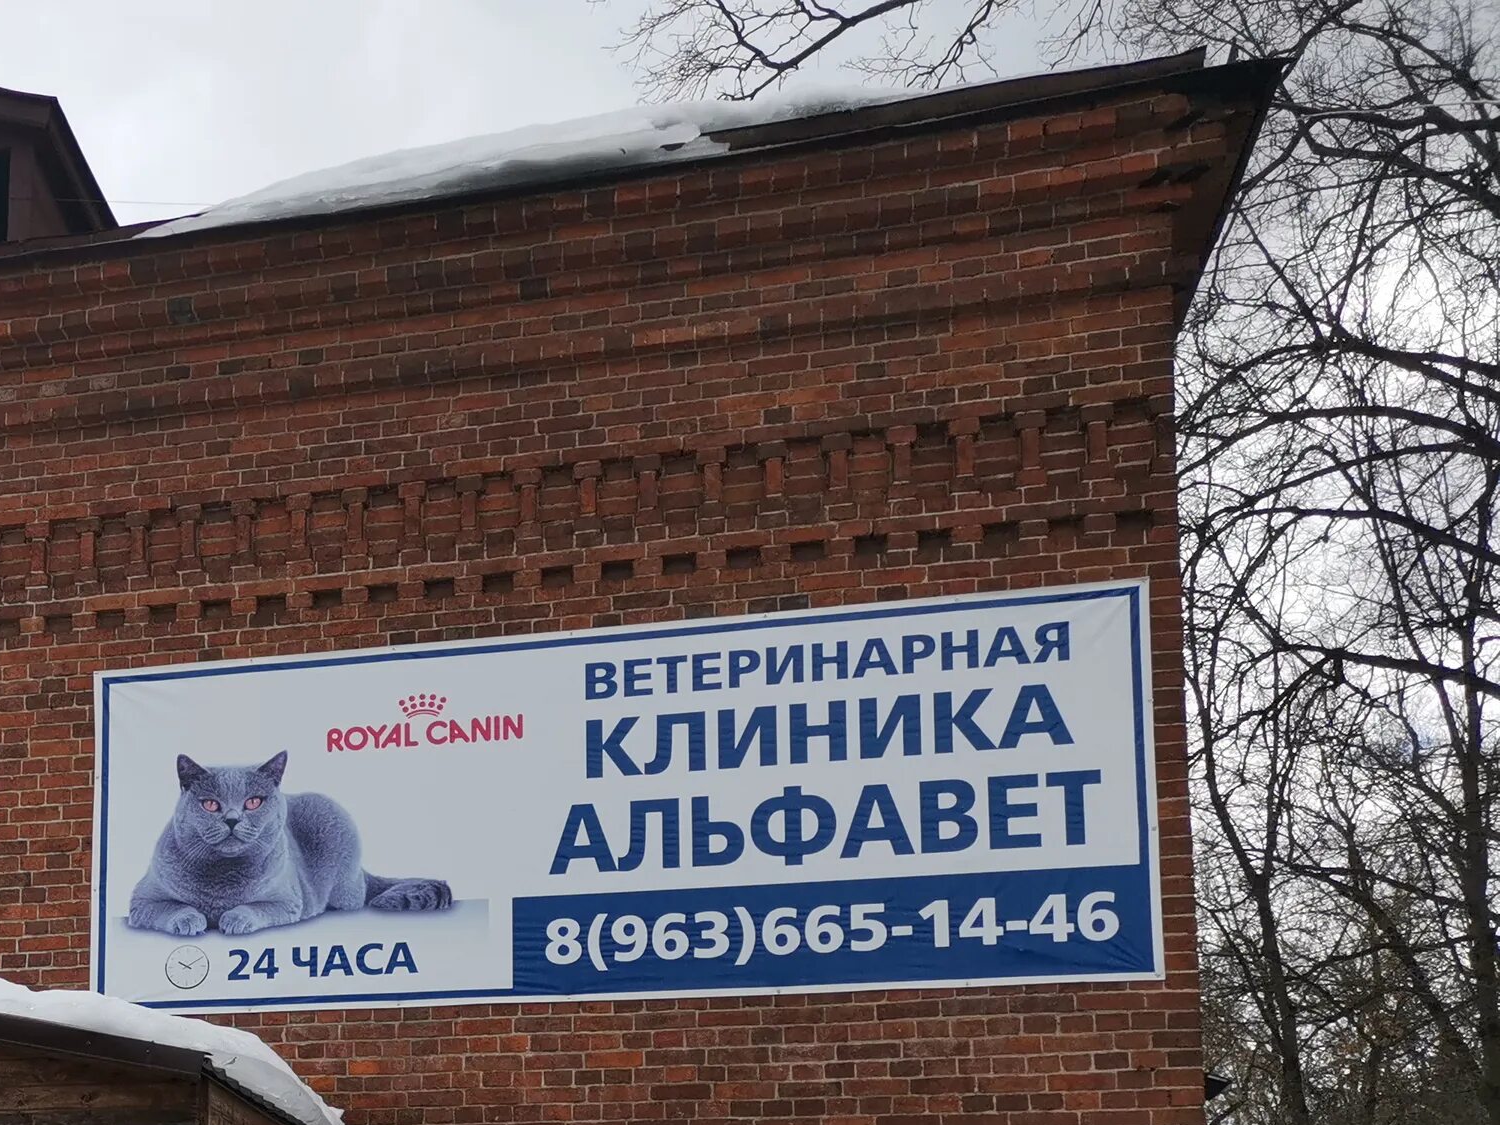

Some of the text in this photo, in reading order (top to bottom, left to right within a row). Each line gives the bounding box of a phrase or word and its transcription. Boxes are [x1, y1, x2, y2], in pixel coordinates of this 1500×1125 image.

[585, 621, 1070, 700] ВЕТЕРИНАРНАЯ
[327, 714, 524, 753] ROYAL CANIN
[585, 684, 1075, 779] КЛИНИКА
[549, 769, 1102, 875] АЛЬФАВЕТ
[227, 942, 419, 981] 24 ЧАСА
[545, 891, 1120, 971] 8(963)665-14-46
